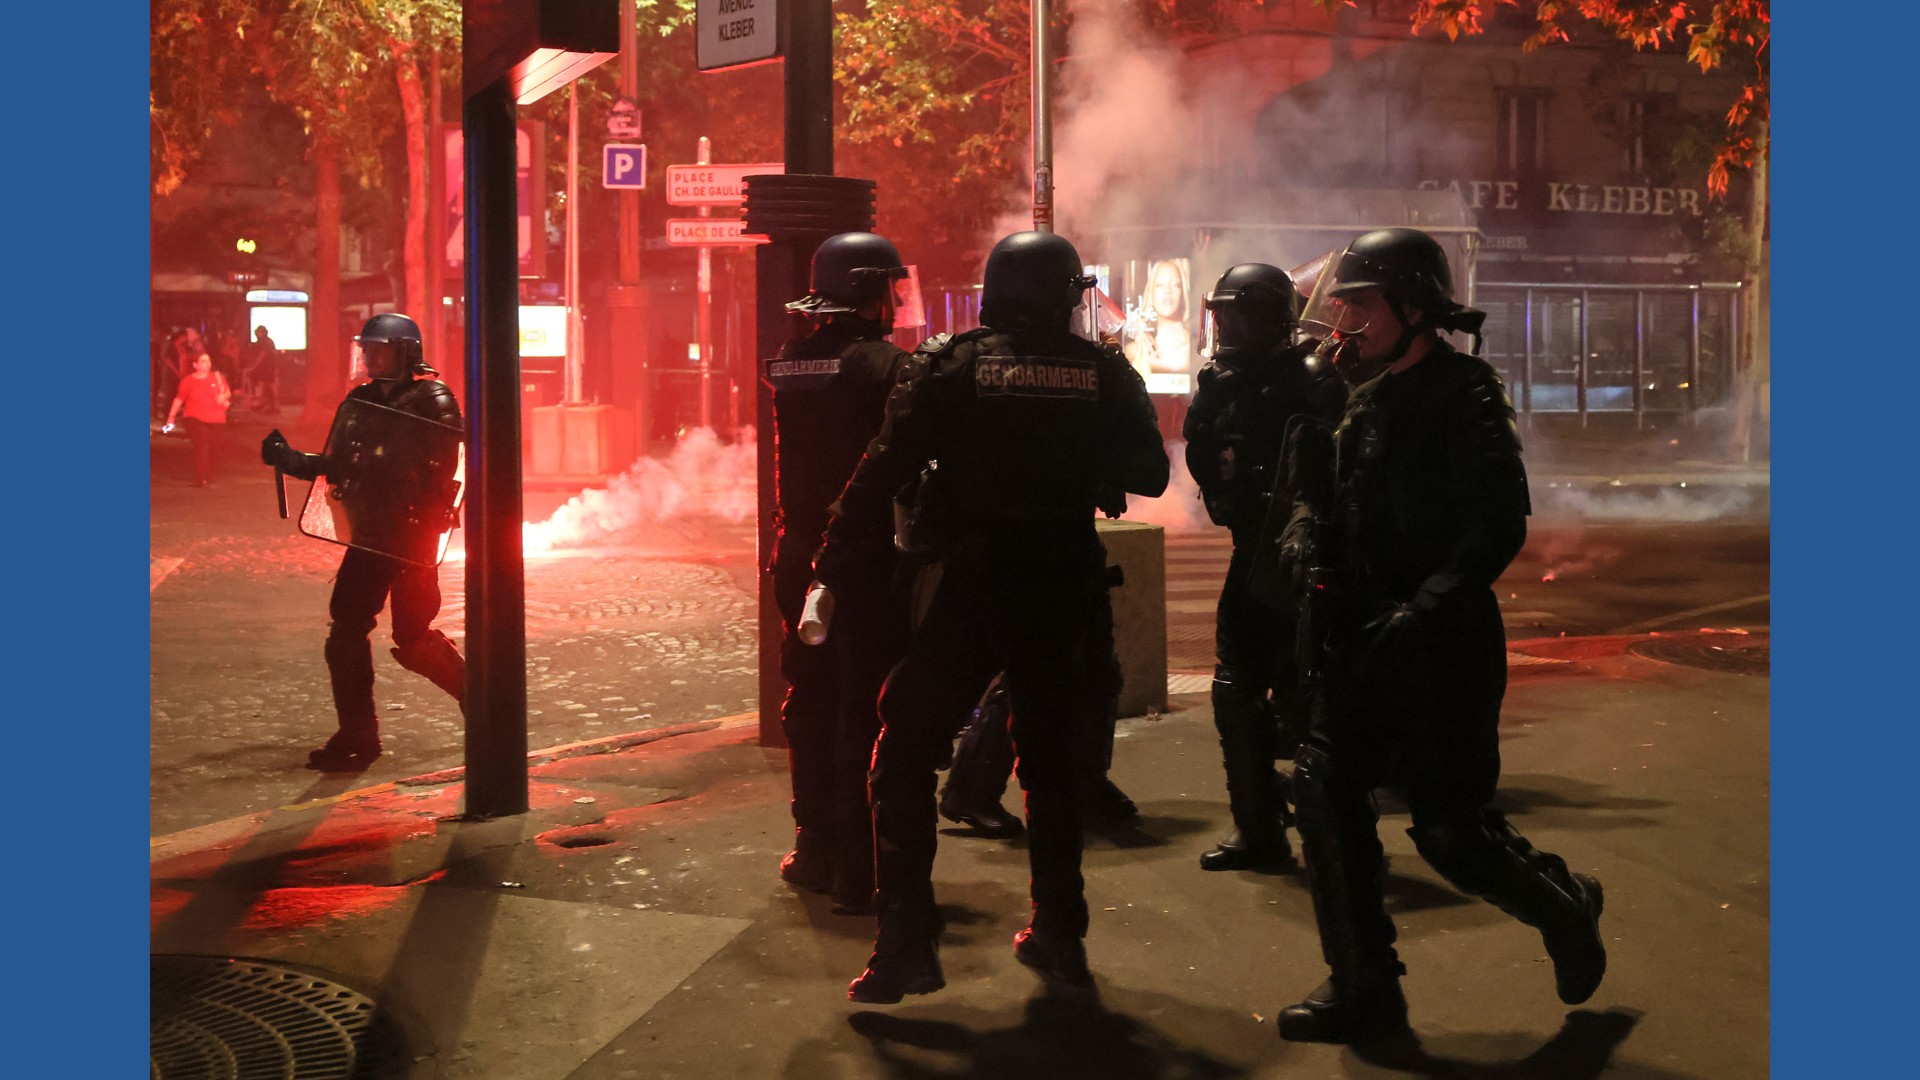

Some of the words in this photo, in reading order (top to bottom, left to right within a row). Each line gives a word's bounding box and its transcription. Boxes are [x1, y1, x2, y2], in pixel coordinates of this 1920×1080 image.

[718, 18, 755, 42] KLEBER
[614, 153, 634, 180] P
[674, 172, 715, 183] PLACE
[674, 187, 691, 197] CH.
[693, 187, 707, 197] DE
[708, 187, 742, 197] GAULL
[1548, 182, 1703, 216] KLEBER
[674, 227, 707, 237] PLACE
[711, 227, 724, 237] DE
[728, 227, 741, 237] CL
[979, 363, 1097, 391] GENDARMERIE
